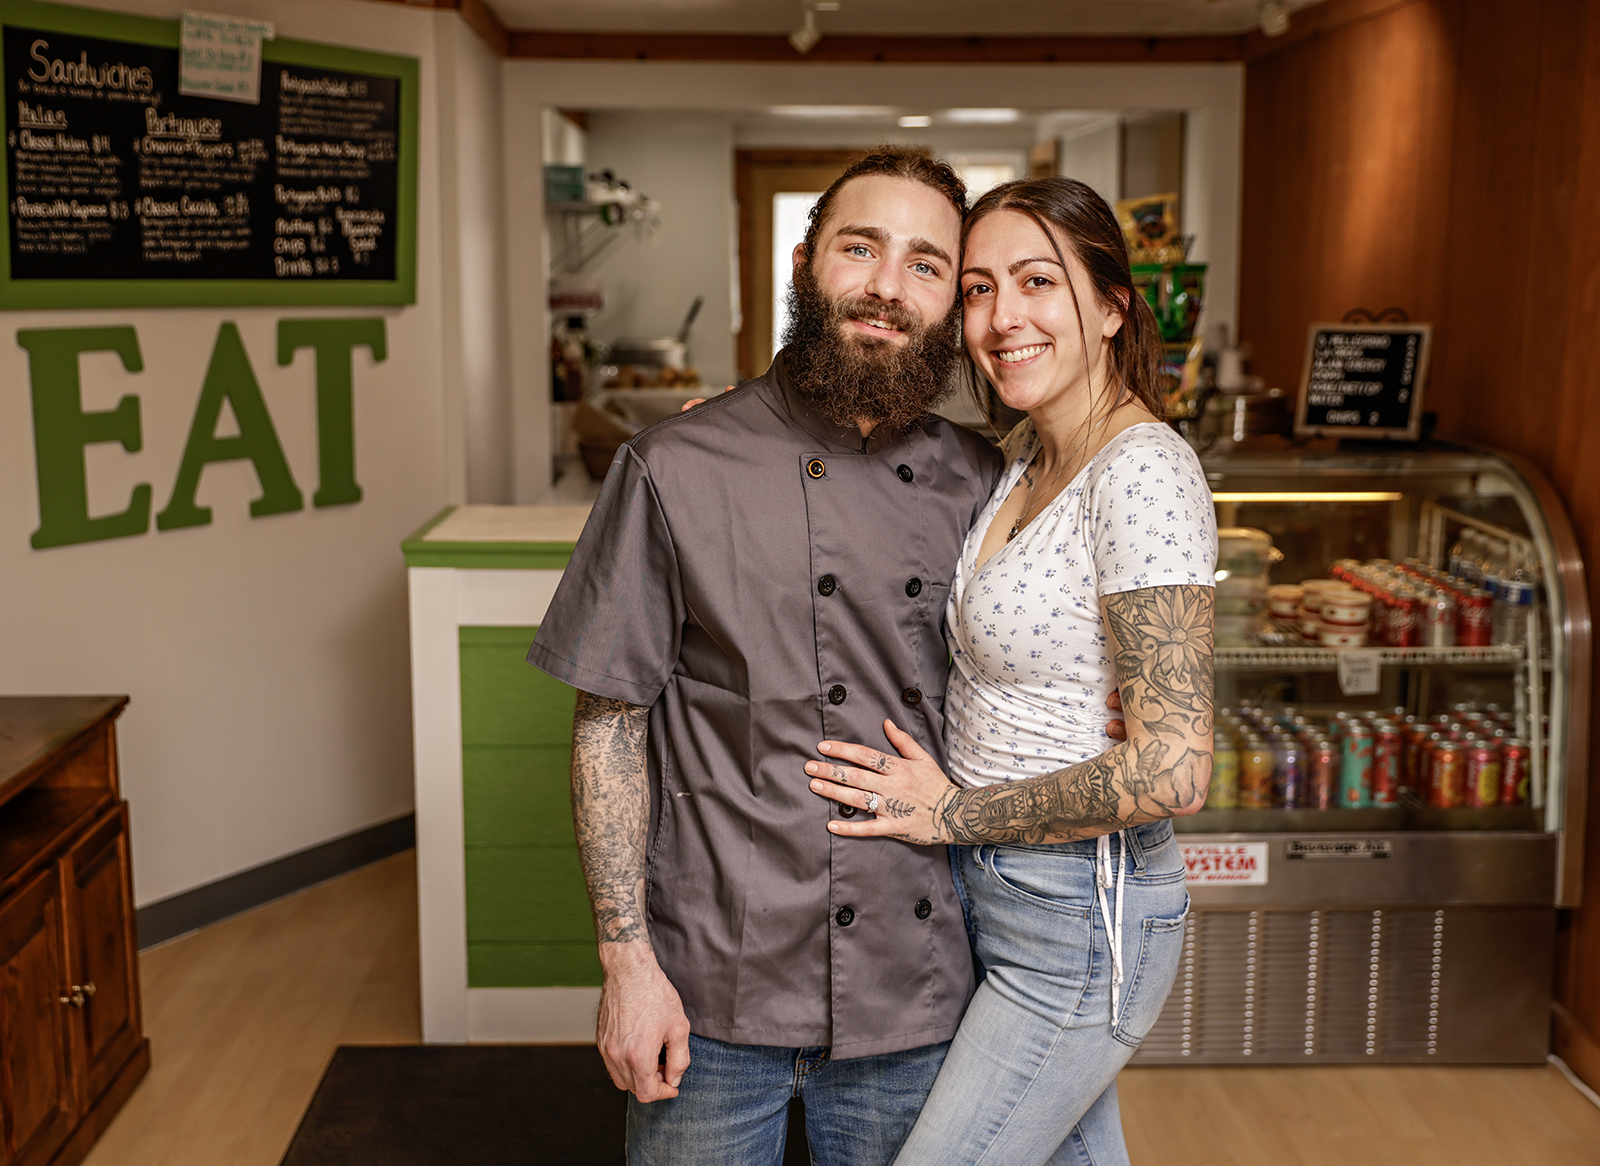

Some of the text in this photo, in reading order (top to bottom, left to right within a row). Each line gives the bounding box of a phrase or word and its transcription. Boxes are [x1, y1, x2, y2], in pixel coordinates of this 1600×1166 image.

[27, 38, 154, 93] Sandwiches
[18, 100, 68, 126] Italian
[145, 107, 222, 138] Portuguese
[20, 129, 56, 151] Classic
[56, 133, 90, 153] Italian
[142, 196, 181, 217] Classic
[274, 237, 306, 259] Chips
[274, 256, 313, 277] Drinks
[1326, 409, 1361, 425] CHIPS
[17, 316, 387, 550] EAT
[1184, 856, 1257, 871] YSTEM
